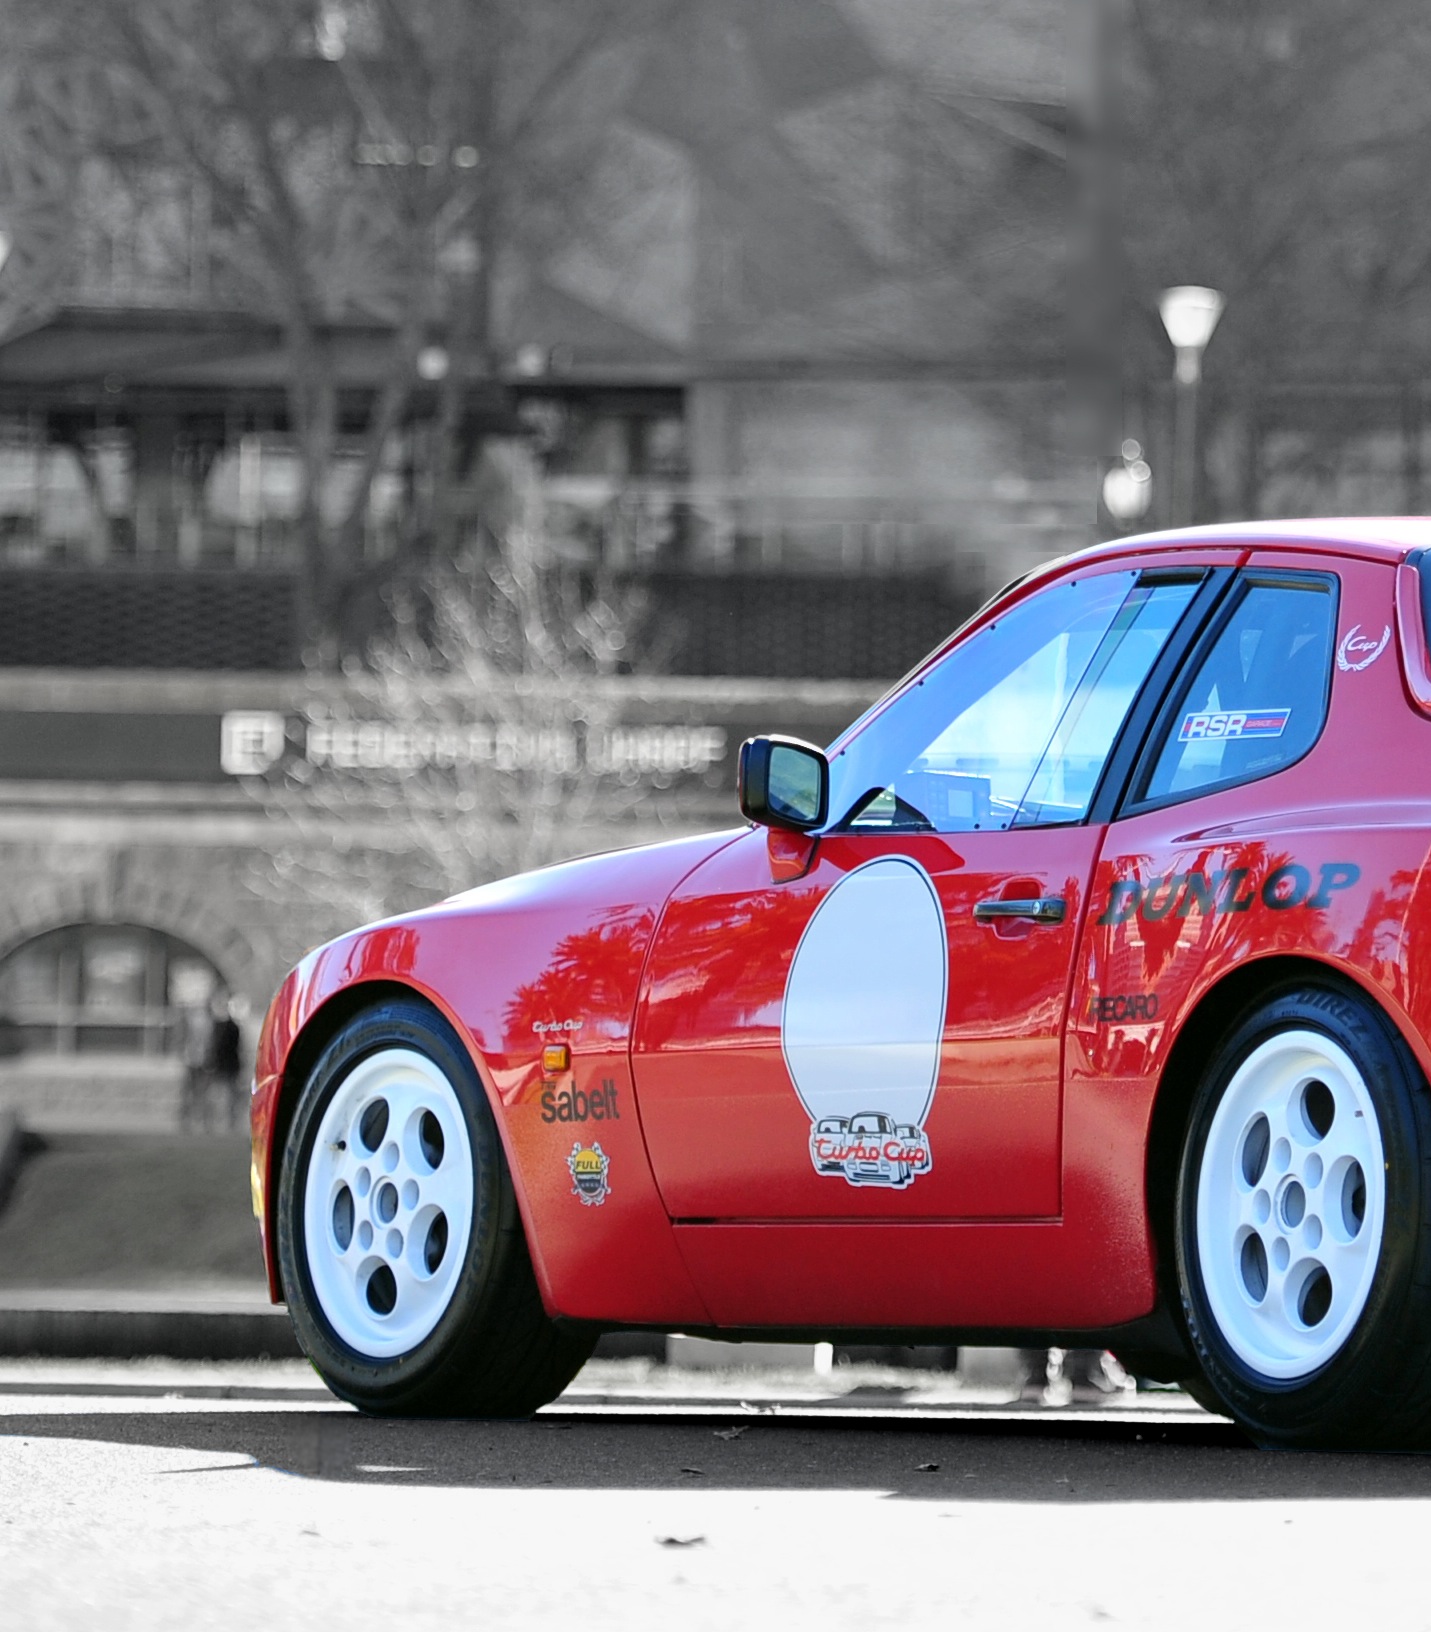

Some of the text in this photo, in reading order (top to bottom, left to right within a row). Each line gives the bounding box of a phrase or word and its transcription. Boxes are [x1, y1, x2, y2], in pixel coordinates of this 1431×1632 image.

[1347, 635, 1378, 652] Cup
[1187, 714, 1247, 738] RSR
[1096, 863, 1361, 926] DUNLOP
[1089, 992, 1158, 1022] RECARO
[541, 1079, 620, 1124] sabelt
[576, 1160, 601, 1170] FULL
[883, 1141, 926, 1167] Cup
